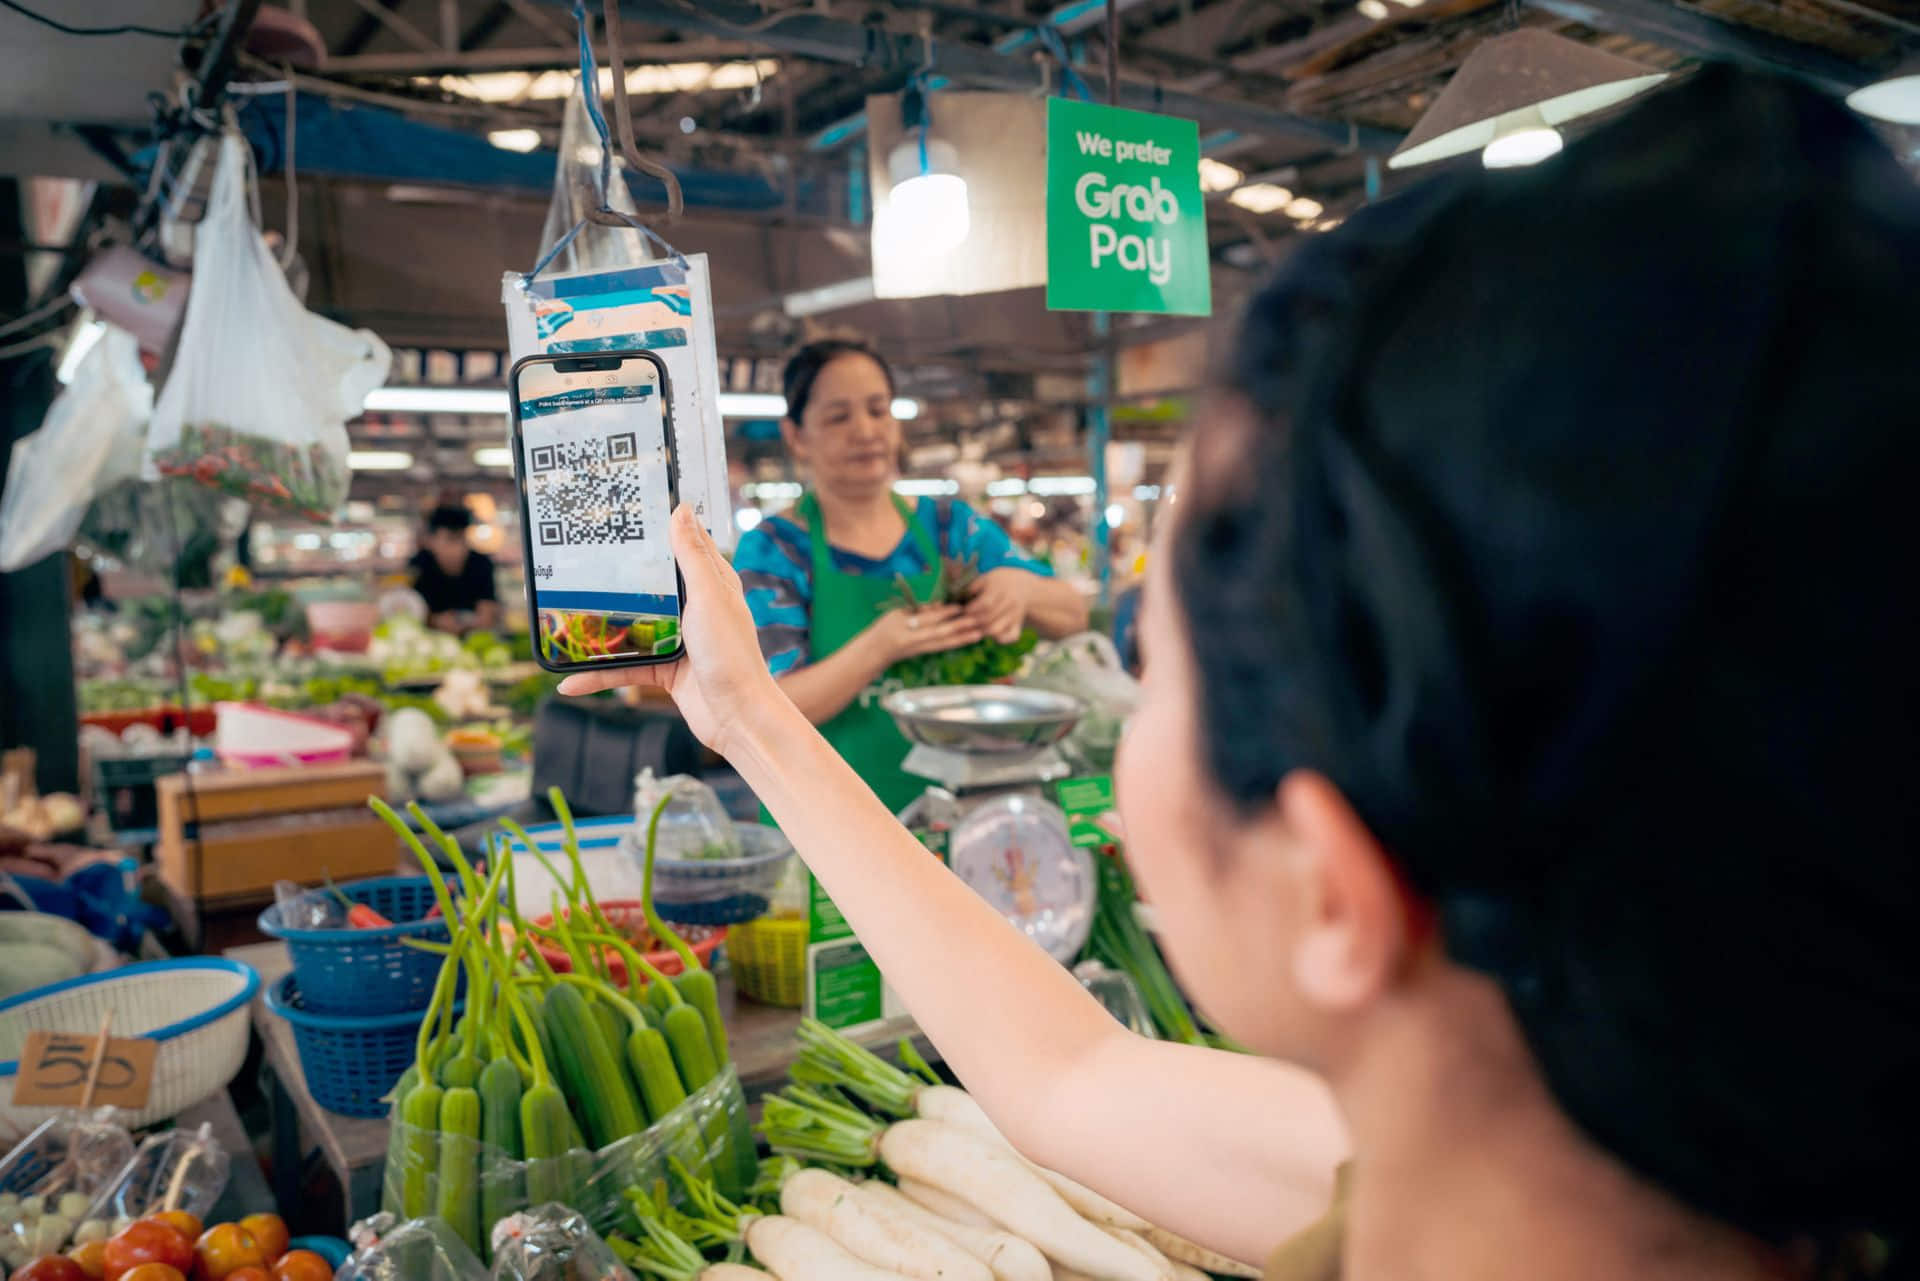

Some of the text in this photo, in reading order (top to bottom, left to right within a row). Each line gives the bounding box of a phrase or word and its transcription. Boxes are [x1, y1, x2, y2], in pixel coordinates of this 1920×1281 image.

[1076, 131, 1173, 166] We prefer
[1075, 171, 1179, 225] Grab
[1090, 223, 1171, 285] Pay
